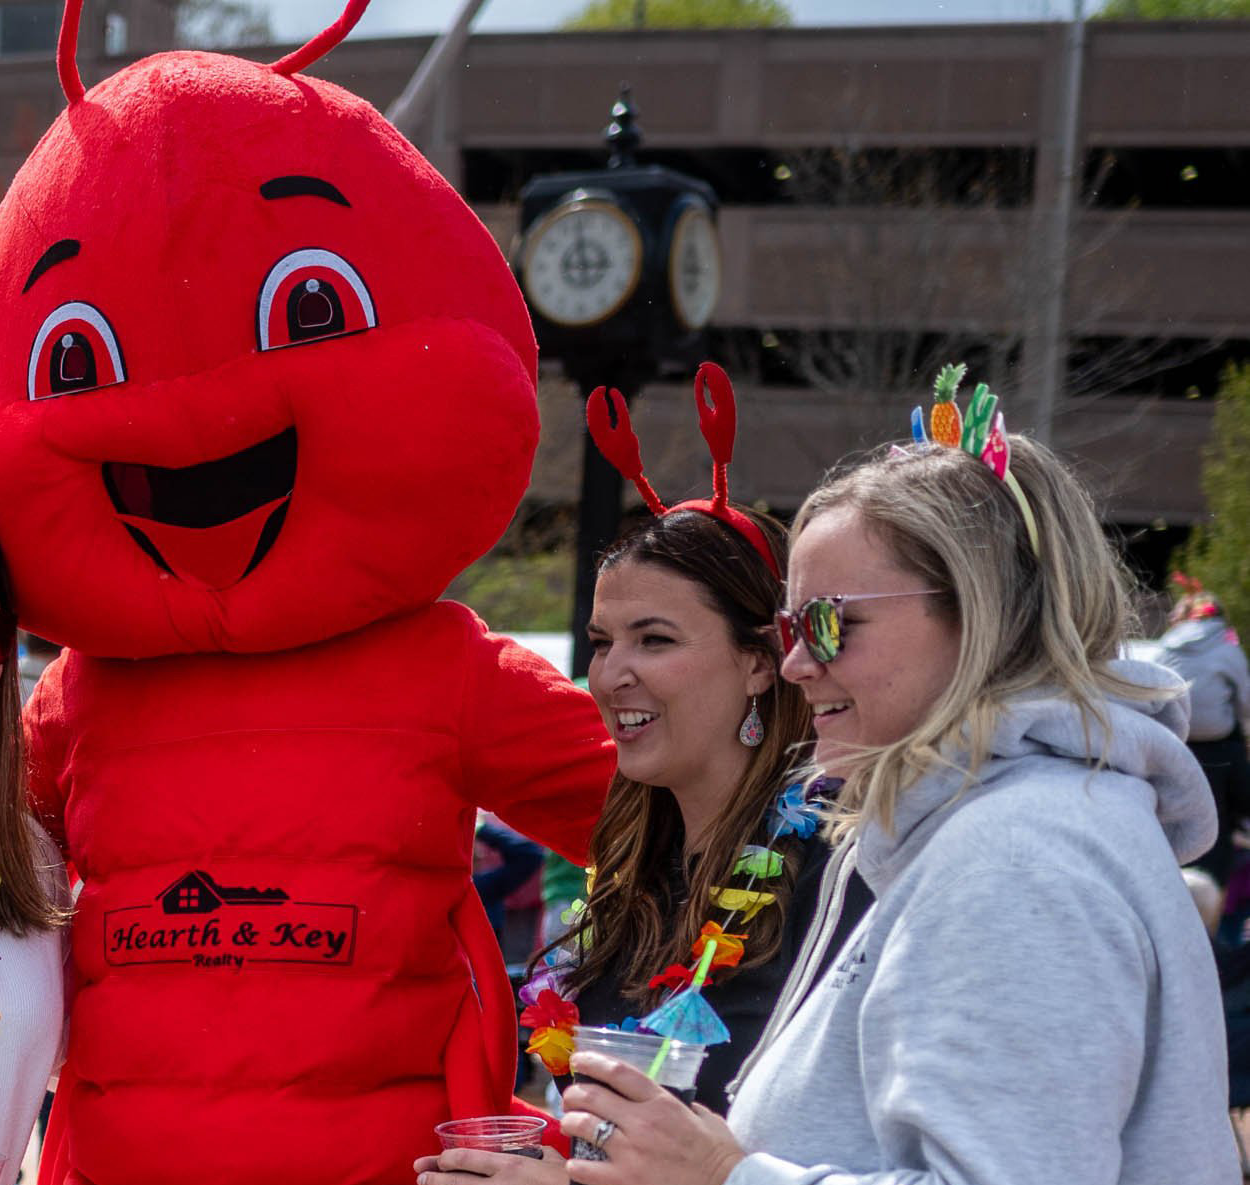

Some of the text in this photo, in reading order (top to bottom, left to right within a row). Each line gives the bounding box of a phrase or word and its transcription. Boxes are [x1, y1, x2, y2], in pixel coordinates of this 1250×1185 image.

[111, 919, 346, 958] Hearth & Key
[193, 953, 244, 970] Realty
